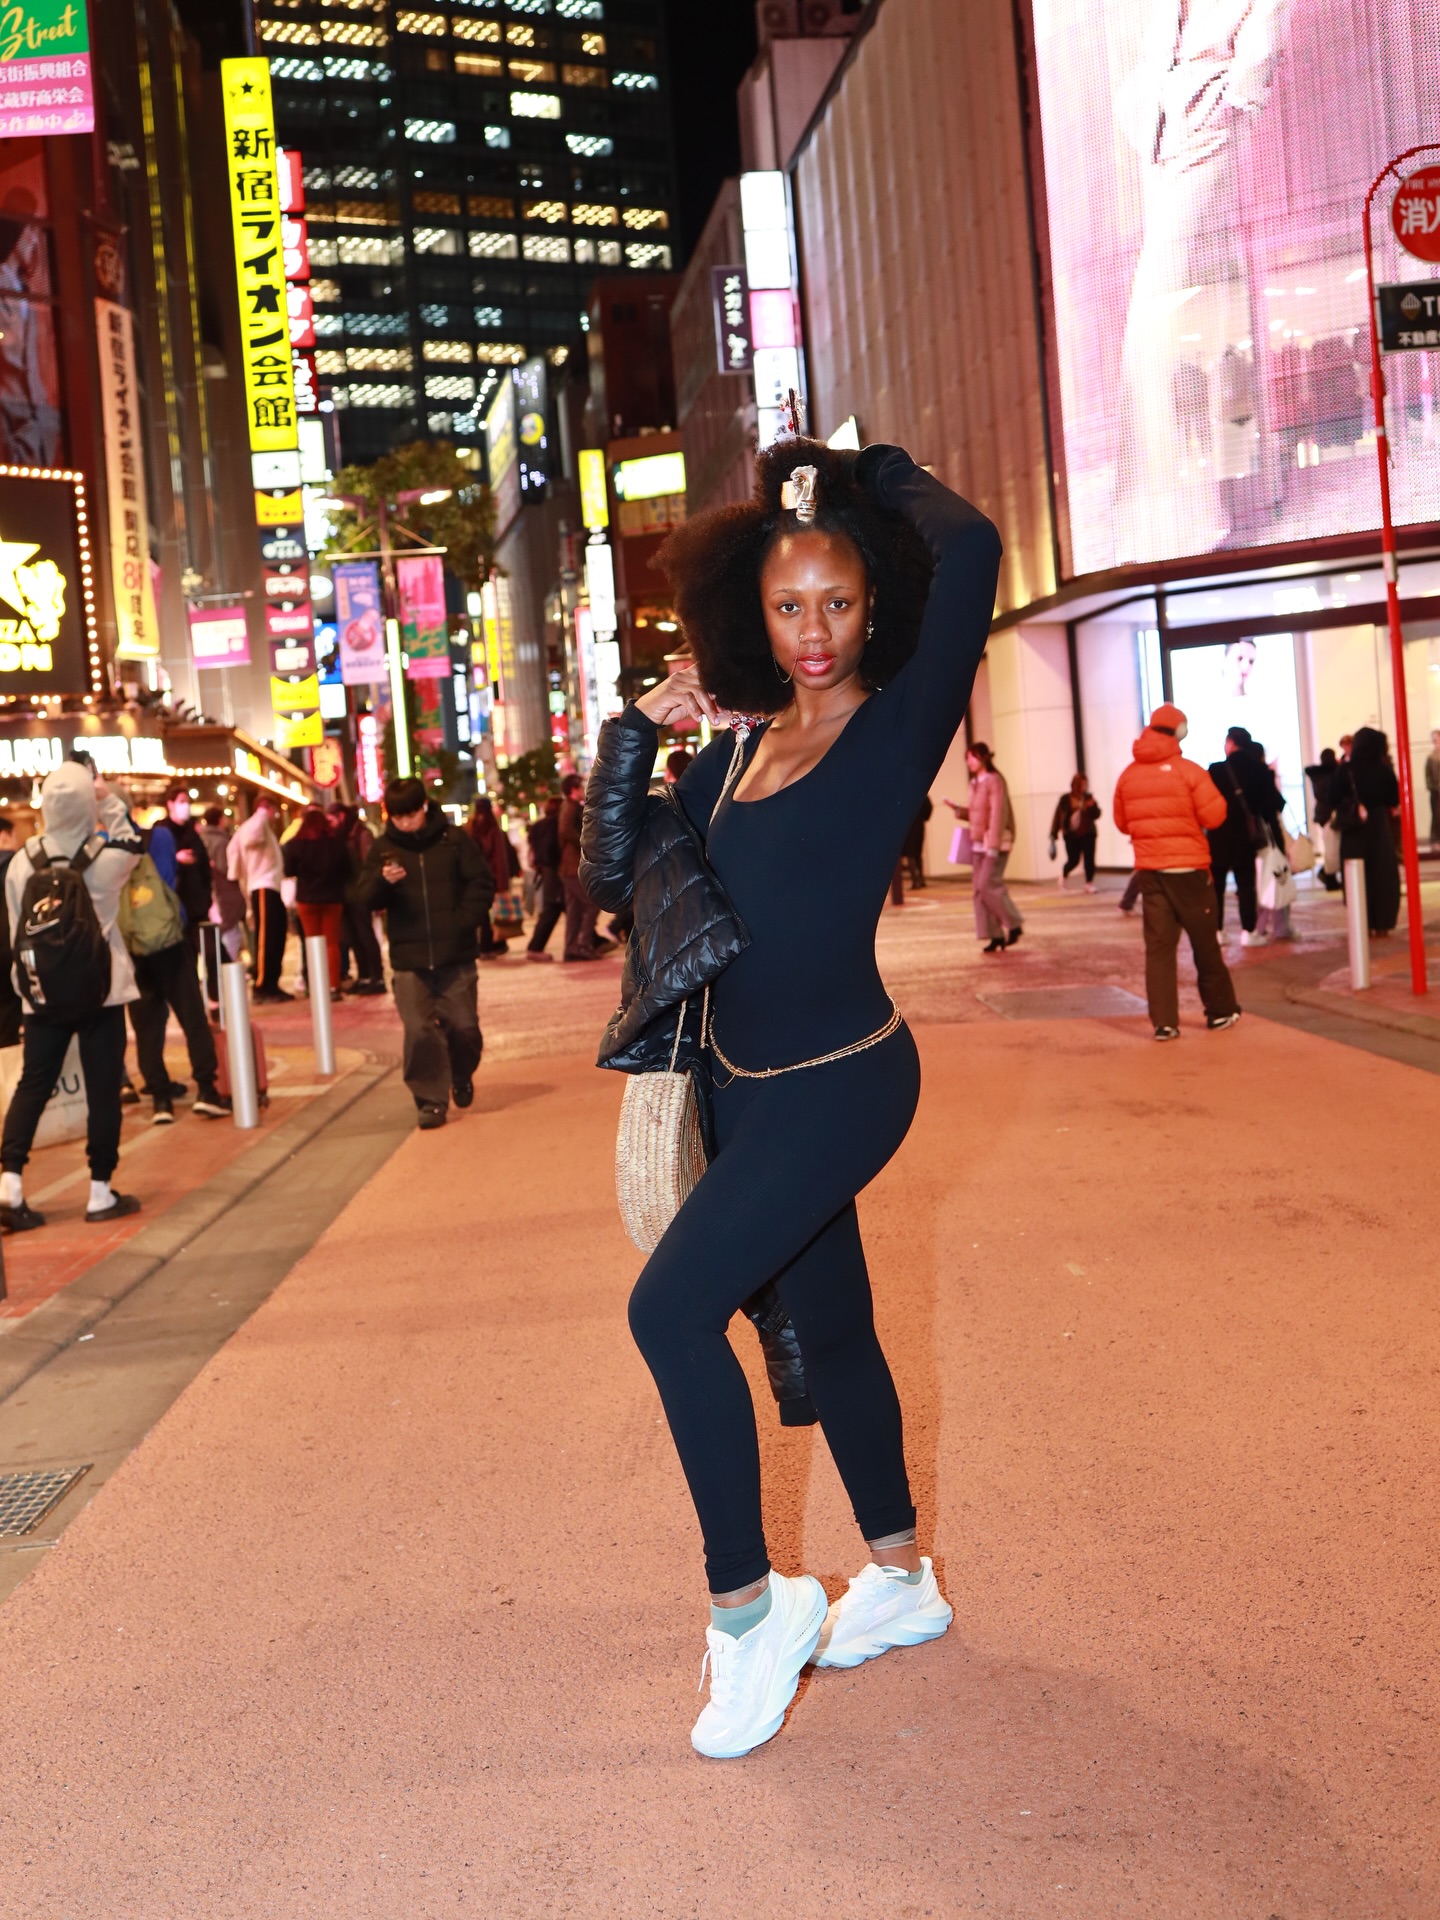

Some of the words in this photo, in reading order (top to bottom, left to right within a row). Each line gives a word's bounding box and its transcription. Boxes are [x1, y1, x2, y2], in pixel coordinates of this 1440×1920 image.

[0, 86, 85, 109] 蔵野商栄会
[233, 128, 291, 427] 新宿ライオン会館
[1397, 329, 1440, 347] 不動産
